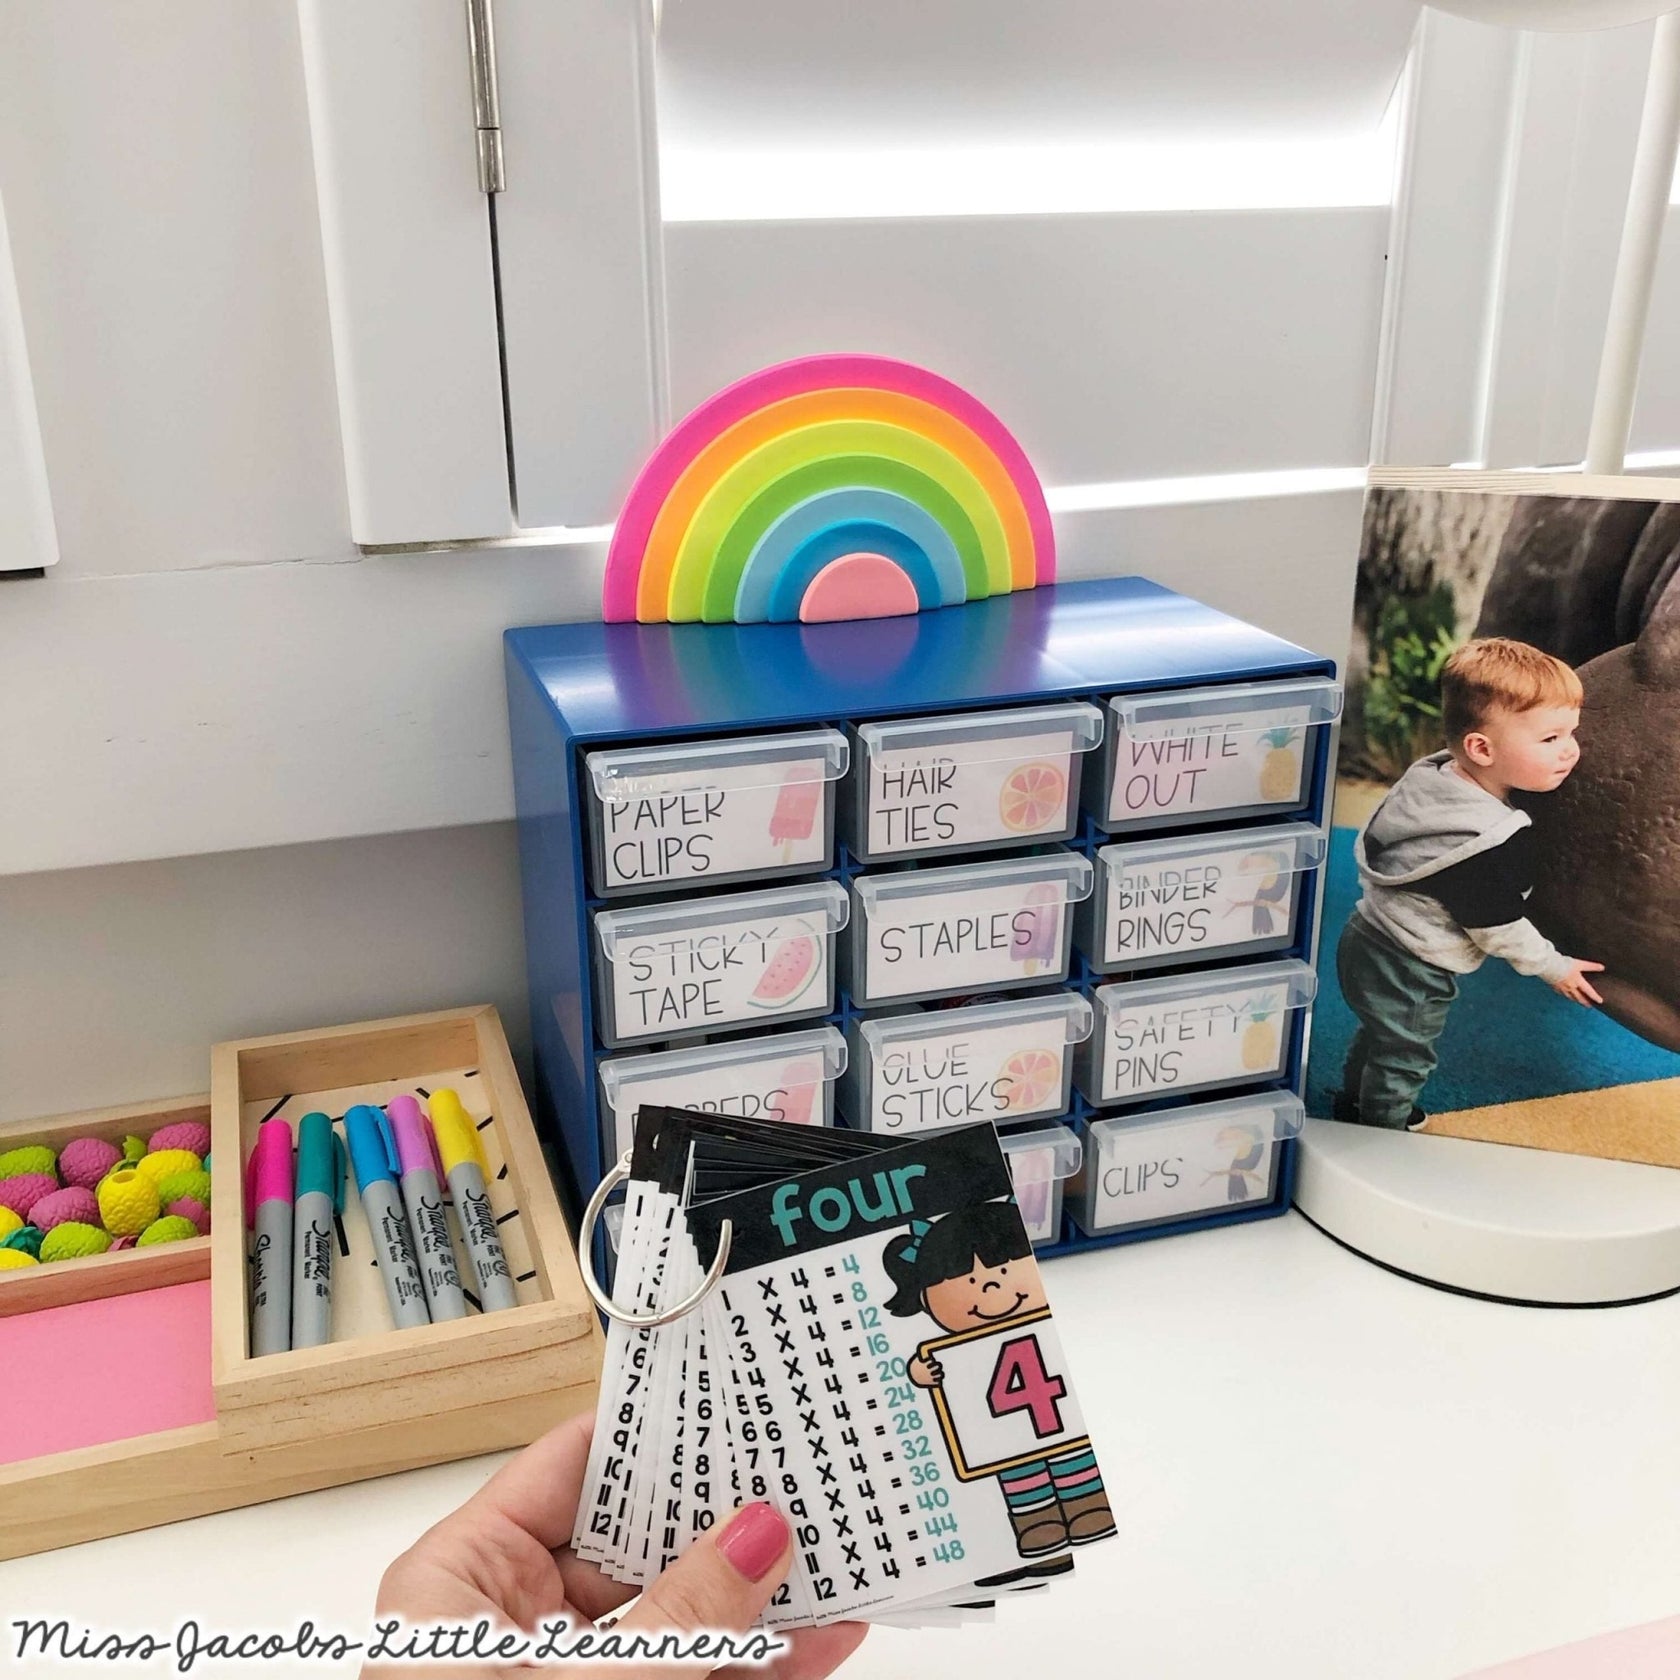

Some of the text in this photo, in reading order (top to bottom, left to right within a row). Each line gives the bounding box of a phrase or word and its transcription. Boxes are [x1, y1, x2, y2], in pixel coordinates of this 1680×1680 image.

[1130, 723, 1245, 768] WHITE
[881, 758, 957, 800] HAIR
[1125, 768, 1208, 810] OUT
[610, 787, 726, 833] PAPER
[875, 802, 960, 846] TIES
[612, 834, 714, 880] CLIPS
[1118, 865, 1223, 910] BINDER
[880, 910, 1038, 964] STAPLES
[1117, 908, 1212, 953] RINGS
[628, 927, 779, 982] STICKY
[629, 979, 724, 1026] TAPE
[1114, 1001, 1251, 1051] SAFETY
[881, 1042, 970, 1087] GLUE
[1114, 1050, 1184, 1091] PINS
[881, 1077, 1014, 1128] STICKS
[1103, 1157, 1185, 1199] CLIPS
[770, 1163, 927, 1247] four
[720, 1290, 731, 1311] 1
[791, 1268, 809, 1288] 4
[843, 1255, 860, 1274] 4
[731, 1315, 749, 1337] 2
[799, 1295, 817, 1315] 4
[852, 1281, 868, 1302] 8
[740, 1342, 757, 1363] 3
[808, 1321, 826, 1341] 4
[860, 1306, 881, 1329] 12
[633, 1347, 647, 1369] 6
[747, 1367, 766, 1388] 4
[816, 1348, 834, 1368] 4
[867, 1333, 889, 1356] 16
[626, 1374, 641, 1395] 7
[698, 1371, 711, 1392] 5
[755, 1394, 774, 1415] 5
[824, 1374, 842, 1394] 4
[876, 1356, 906, 1382] 20
[986, 1333, 1068, 1440] 4
[618, 1402, 634, 1424] 8
[697, 1399, 712, 1420] 6
[736, 1394, 750, 1415] 5
[766, 1421, 781, 1441] 6
[833, 1401, 850, 1421] 4
[884, 1383, 915, 1408] 24
[613, 1429, 629, 1452] 9
[696, 1427, 710, 1448] 7
[742, 1421, 758, 1442] 6
[772, 1447, 785, 1468] 7
[841, 1427, 859, 1447] 4
[892, 1409, 923, 1435] 28
[695, 1454, 710, 1476] 8
[745, 1448, 759, 1470] 7
[782, 1474, 798, 1494] 8
[850, 1453, 867, 1473] 4
[901, 1435, 931, 1460] 32
[597, 1483, 612, 1506] 11
[694, 1482, 710, 1503] 9
[752, 1475, 767, 1497] 8
[790, 1498, 808, 1519] 9
[858, 1479, 875, 1499] 4
[909, 1462, 939, 1485] 36
[590, 1511, 612, 1536] 12
[663, 1527, 675, 1549] 11
[692, 1509, 715, 1531] 10
[797, 1524, 819, 1548] 10
[866, 1506, 883, 1526] 4
[917, 1487, 949, 1510] 40
[805, 1552, 820, 1574] 11
[874, 1532, 892, 1552] 4
[925, 1516, 957, 1536] 44
[813, 1577, 837, 1601] 12
[882, 1558, 900, 1578] 4
[933, 1540, 965, 1562] 48
